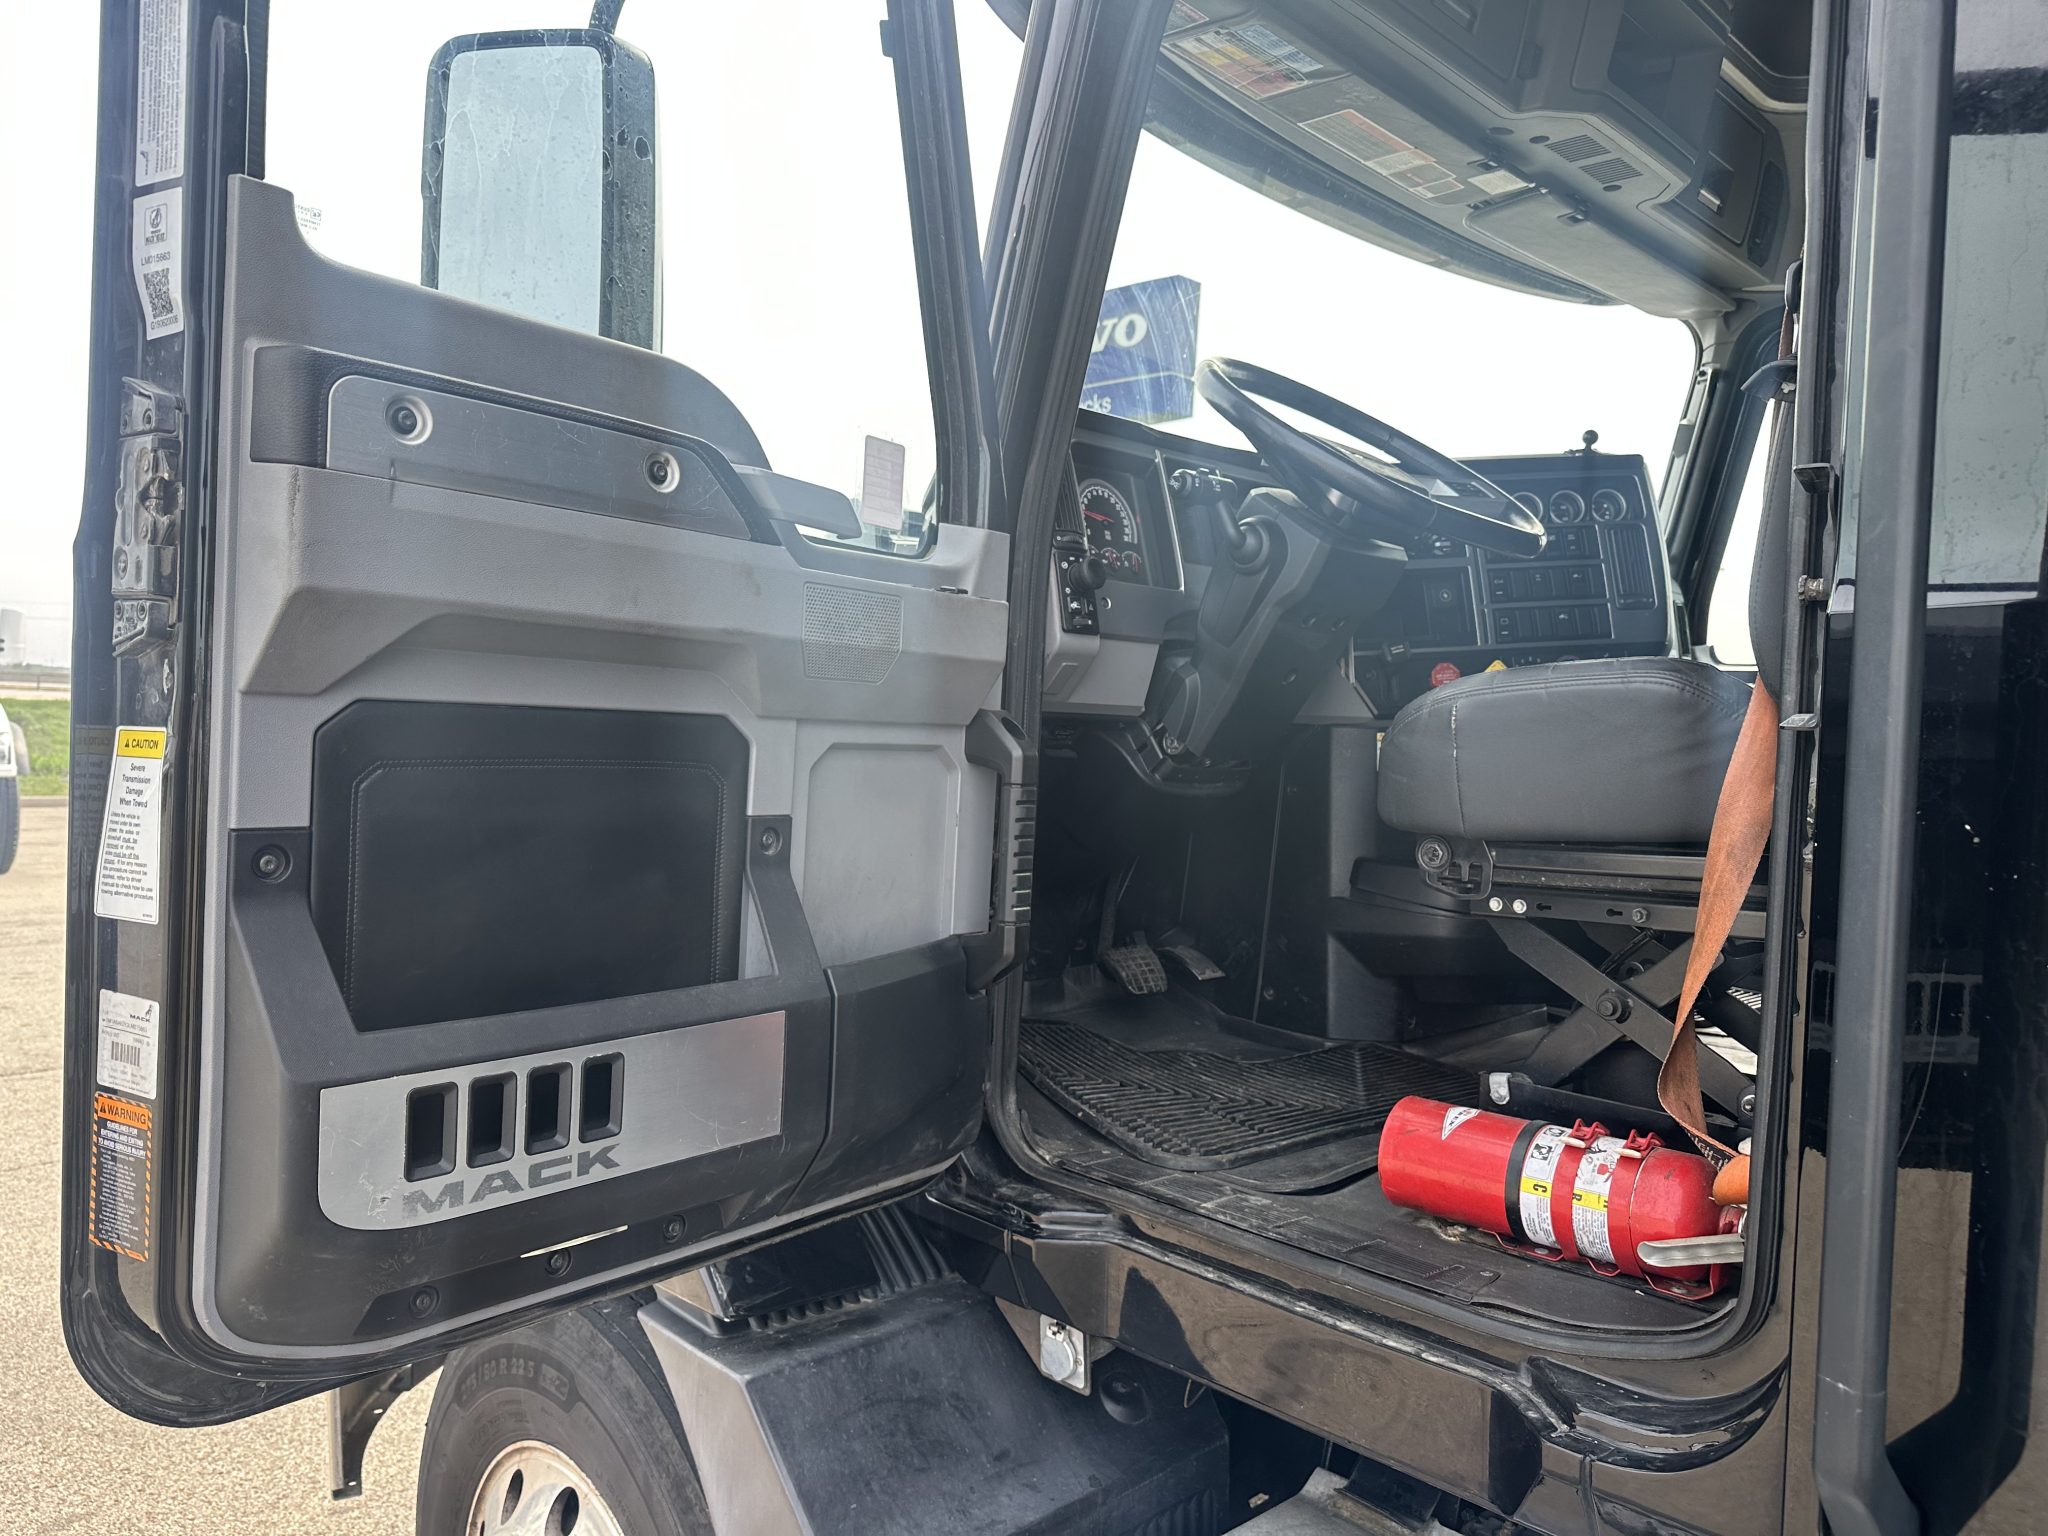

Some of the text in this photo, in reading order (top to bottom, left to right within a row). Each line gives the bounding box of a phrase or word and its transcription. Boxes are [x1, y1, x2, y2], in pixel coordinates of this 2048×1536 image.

[131, 739, 159, 750] CAUTION
[130, 763, 145, 772] Severe
[122, 774, 151, 784] Transmission
[125, 786, 143, 797] Damage
[120, 797, 147, 808] When Towed
[130, 1014, 150, 1023] MACK
[107, 1104, 146, 1124] WARNING
[402, 1143, 622, 1219] MACK
[1533, 1183, 1547, 1193] C
